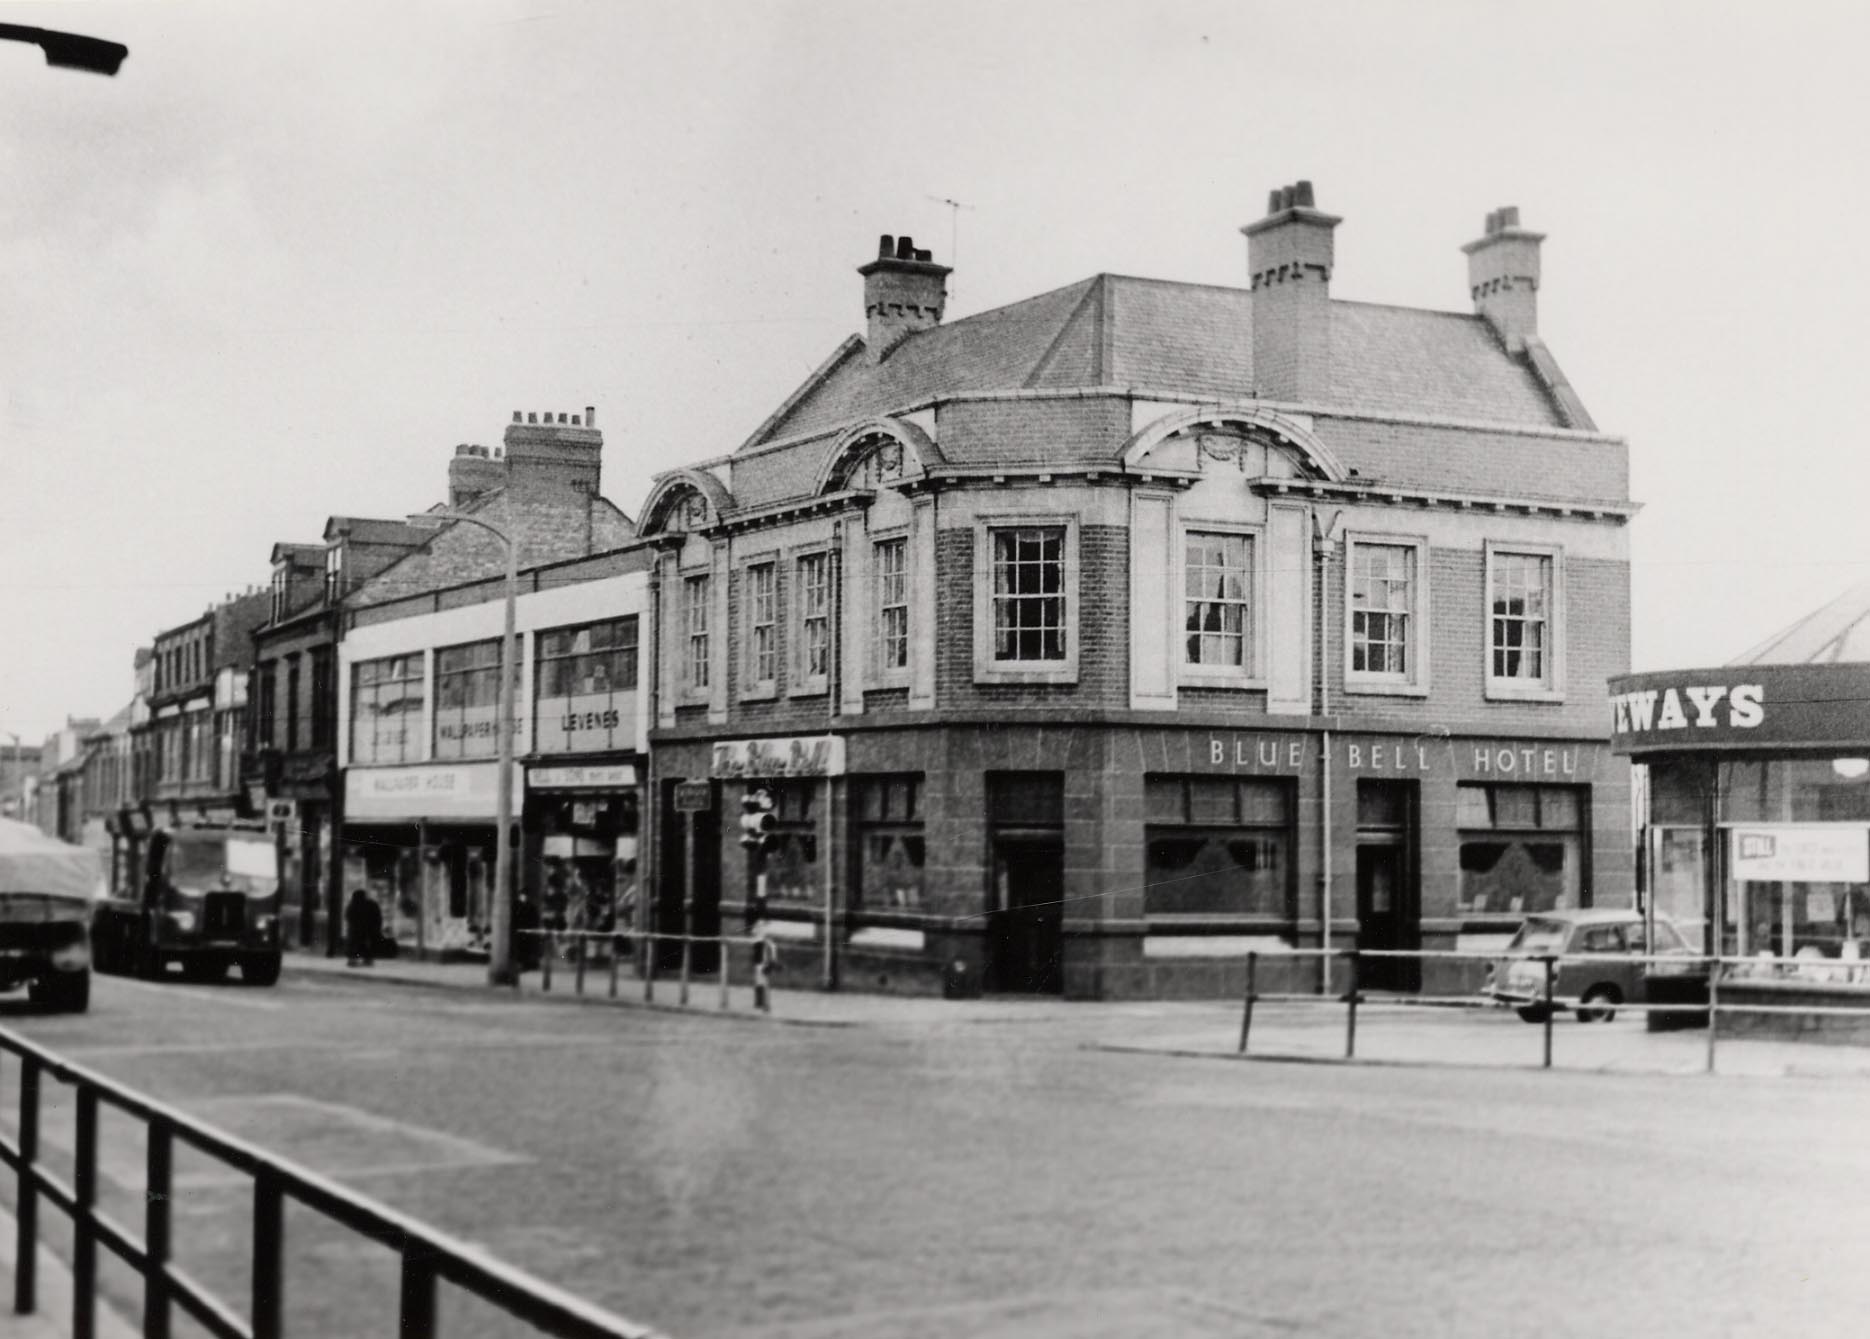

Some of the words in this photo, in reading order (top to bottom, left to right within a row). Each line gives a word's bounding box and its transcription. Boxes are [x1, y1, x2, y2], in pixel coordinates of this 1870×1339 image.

[1210, 739, 1302, 766] BLUE
[1348, 743, 1431, 771] BELL
[1474, 747, 1574, 775] HOTEL
